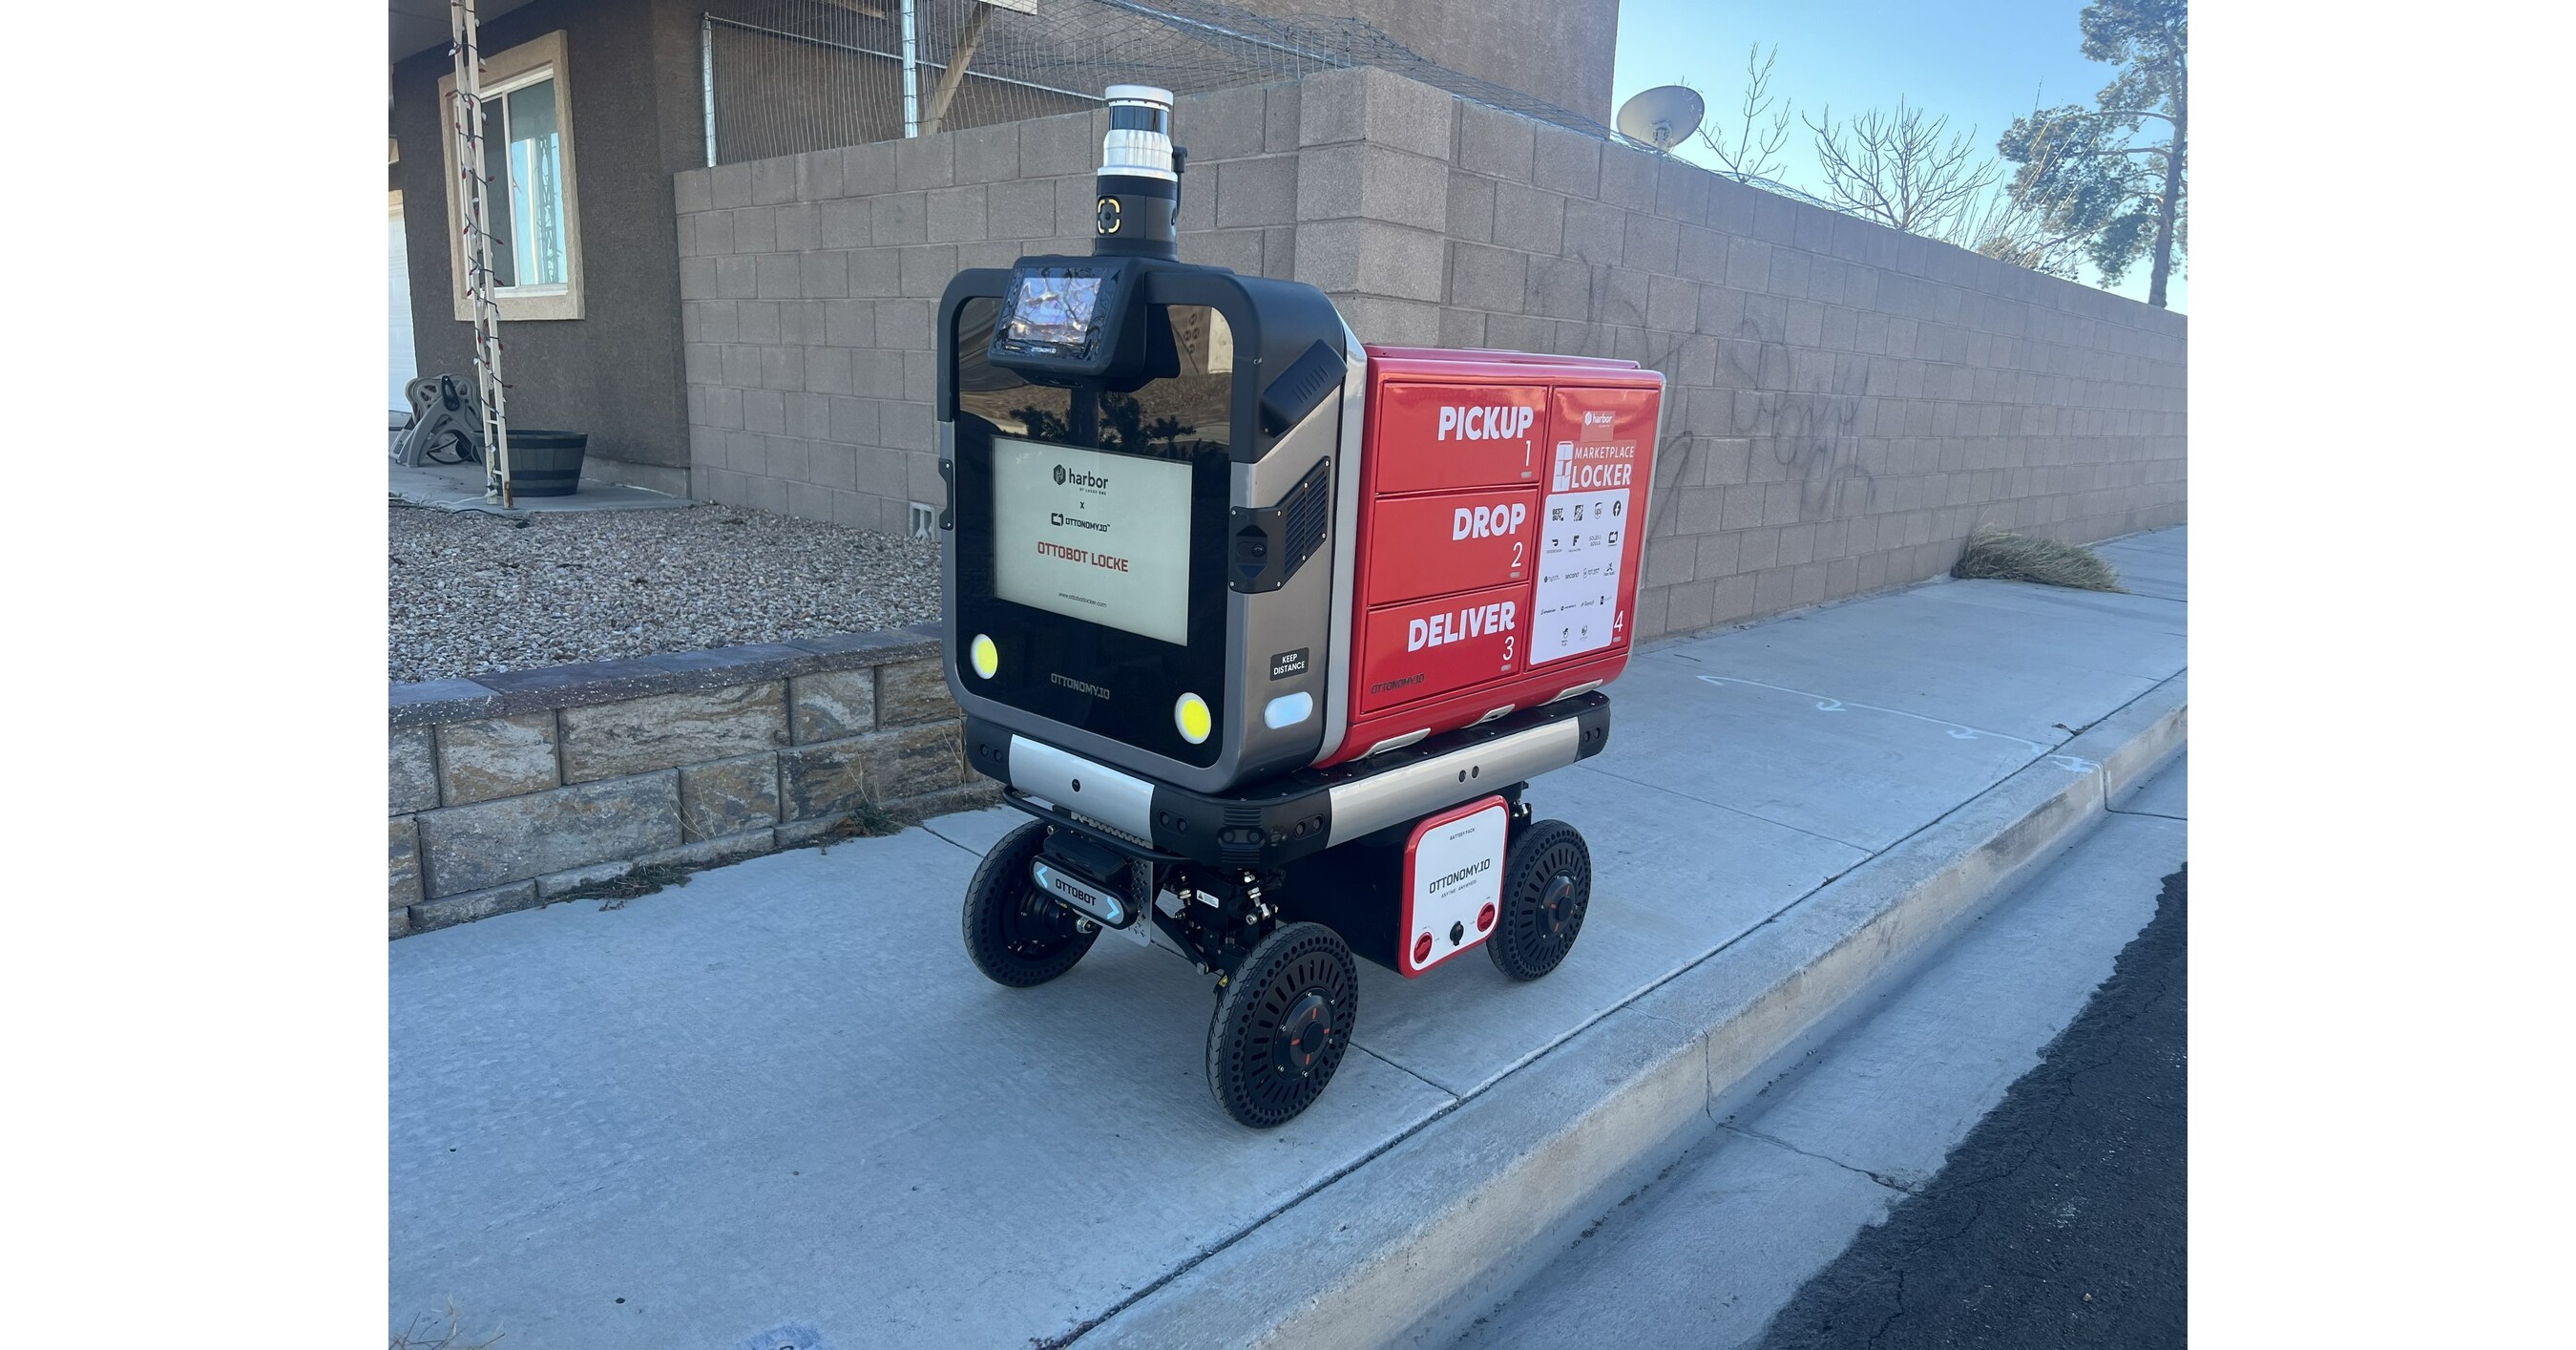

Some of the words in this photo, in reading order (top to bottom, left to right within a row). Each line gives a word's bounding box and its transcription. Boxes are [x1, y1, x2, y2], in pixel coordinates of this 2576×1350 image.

[1437, 406, 1534, 441] PICKUP
[1525, 440, 1531, 467] 1
[1575, 446, 1635, 459] MARKETPLACE
[1069, 467, 1109, 489] harbor
[1571, 463, 1632, 489] LOCKER
[1452, 502, 1526, 541] DROP
[1037, 541, 1088, 563] OTTOBOT
[1091, 553, 1129, 573] LOCKE
[1511, 541, 1522, 568] 2
[1407, 601, 1516, 652] DELIVER
[1614, 610, 1623, 632] 4
[1282, 653, 1298, 664] KEEP
[1503, 636, 1514, 661] 3
[1273, 661, 1306, 676] DISTANCE
[1051, 672, 1111, 700] OTTONOMY.IO
[1429, 857, 1491, 895] OTTONOMY.IO
[1056, 878, 1097, 907] OTTOBOT
